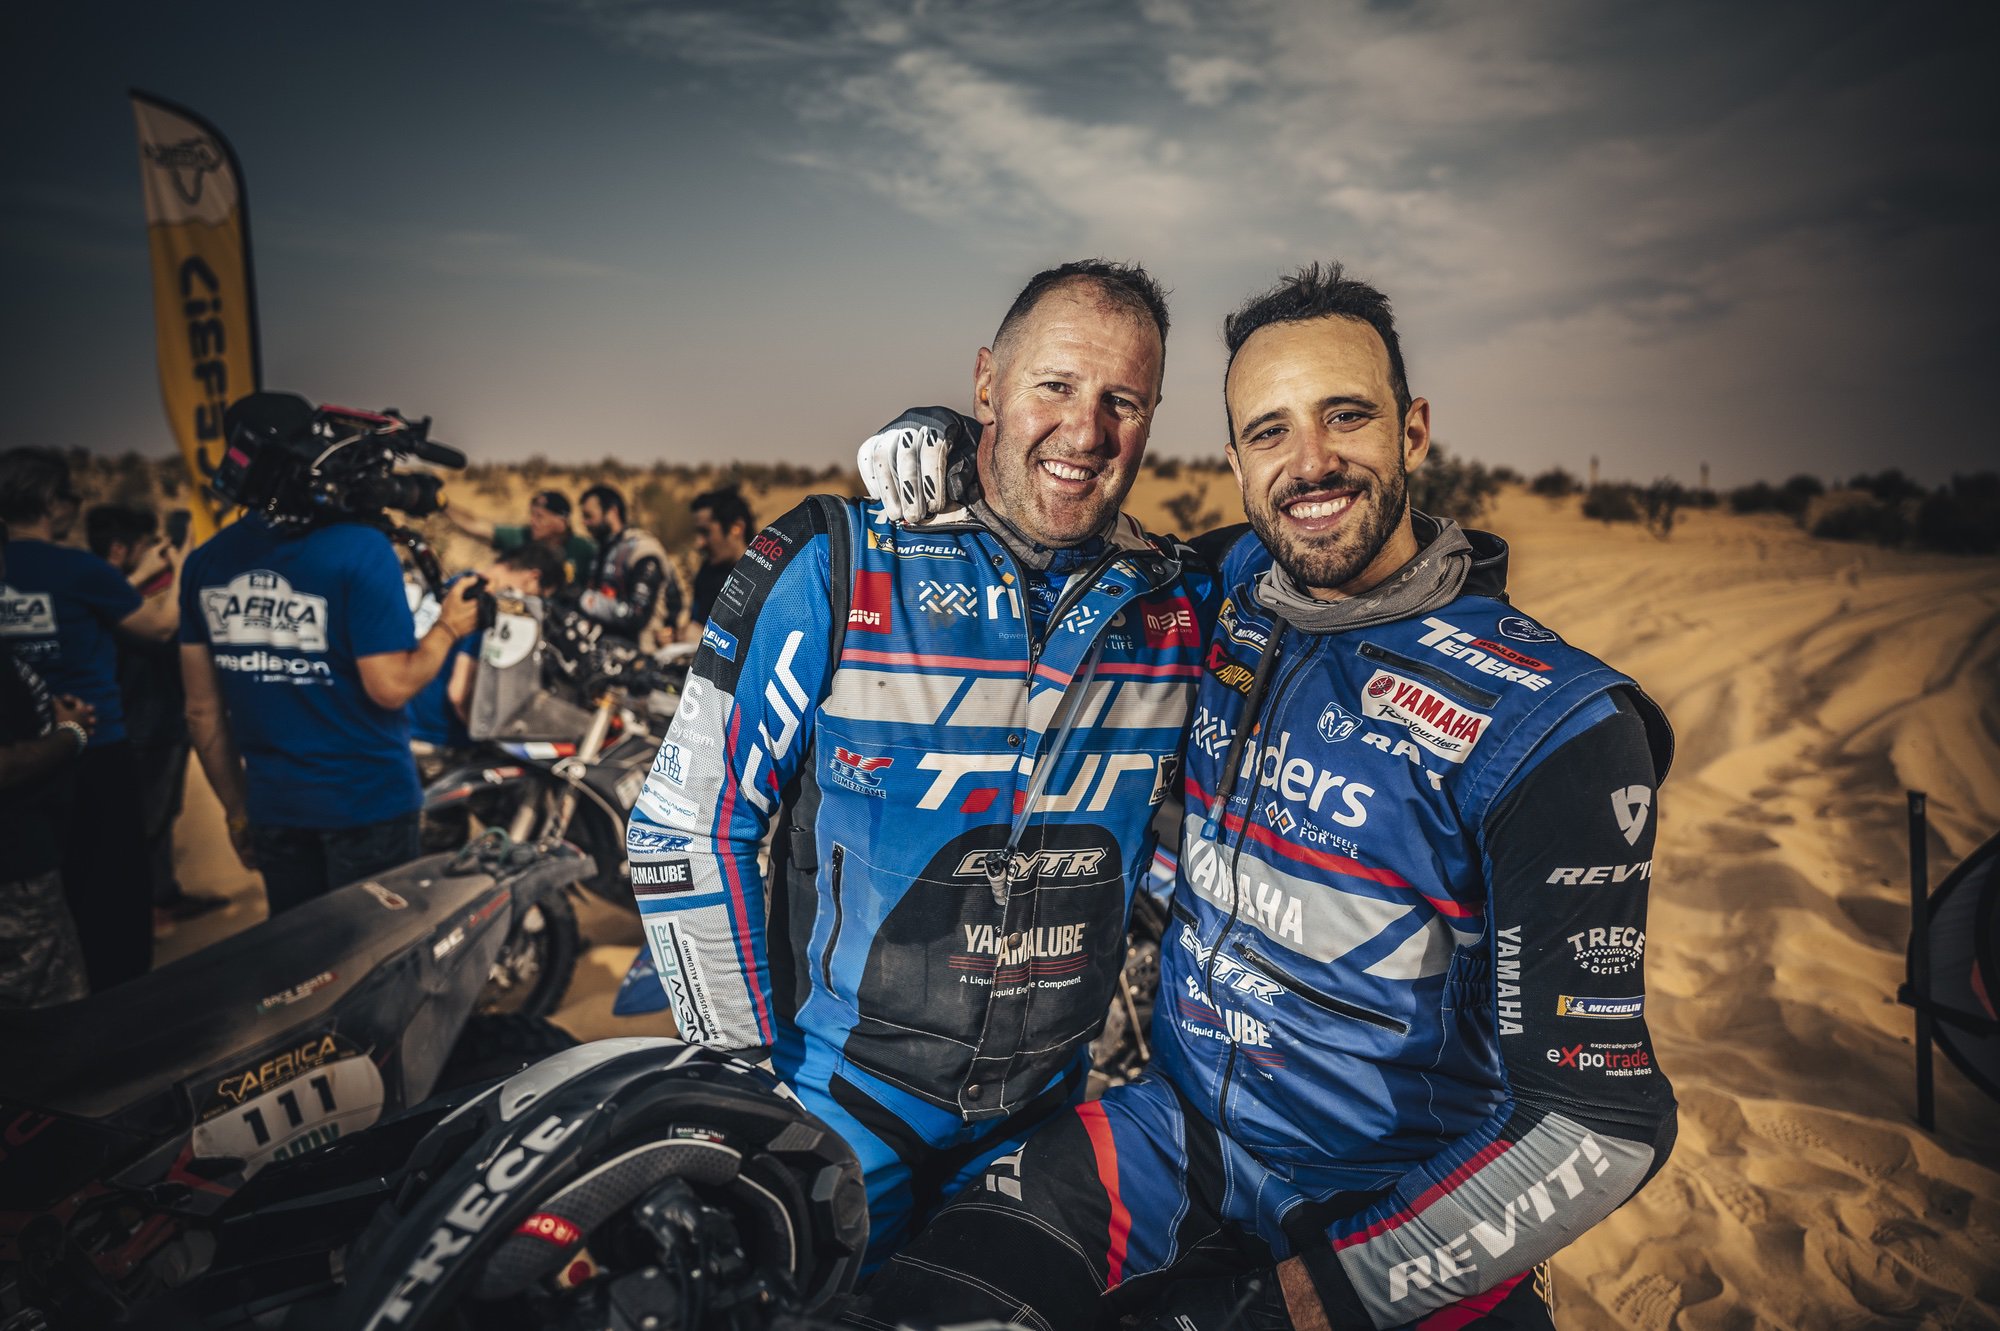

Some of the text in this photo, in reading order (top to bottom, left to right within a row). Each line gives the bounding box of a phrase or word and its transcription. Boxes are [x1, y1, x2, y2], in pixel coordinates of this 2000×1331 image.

[897, 544, 967, 557] MICHELIN
[222, 594, 318, 625] AFRICA
[848, 609, 881, 626] GIVI
[1478, 640, 1542, 668] WORLD RAID
[1391, 682, 1483, 744] YAMAHA
[832, 772, 887, 800] LUMEZZANE
[1299, 826, 1327, 845] FOR
[1303, 817, 1358, 851] TWO WHEELS
[1186, 832, 1304, 945] YAMAHA
[1567, 926, 1646, 955] TRECE
[1580, 961, 1637, 975] SOCIETY
[1593, 956, 1626, 964] RACING
[1037, 975, 1082, 990] Component
[1496, 925, 1524, 1035] YAMAHA
[1588, 1003, 1642, 1014] MICHELIN
[1187, 1024, 1214, 1038] Liquid
[237, 1034, 337, 1098] AFRICA
[1606, 1067, 1652, 1077] mobile ideas
[242, 1075, 337, 1146] 111
[362, 1115, 584, 1331] TRECE
